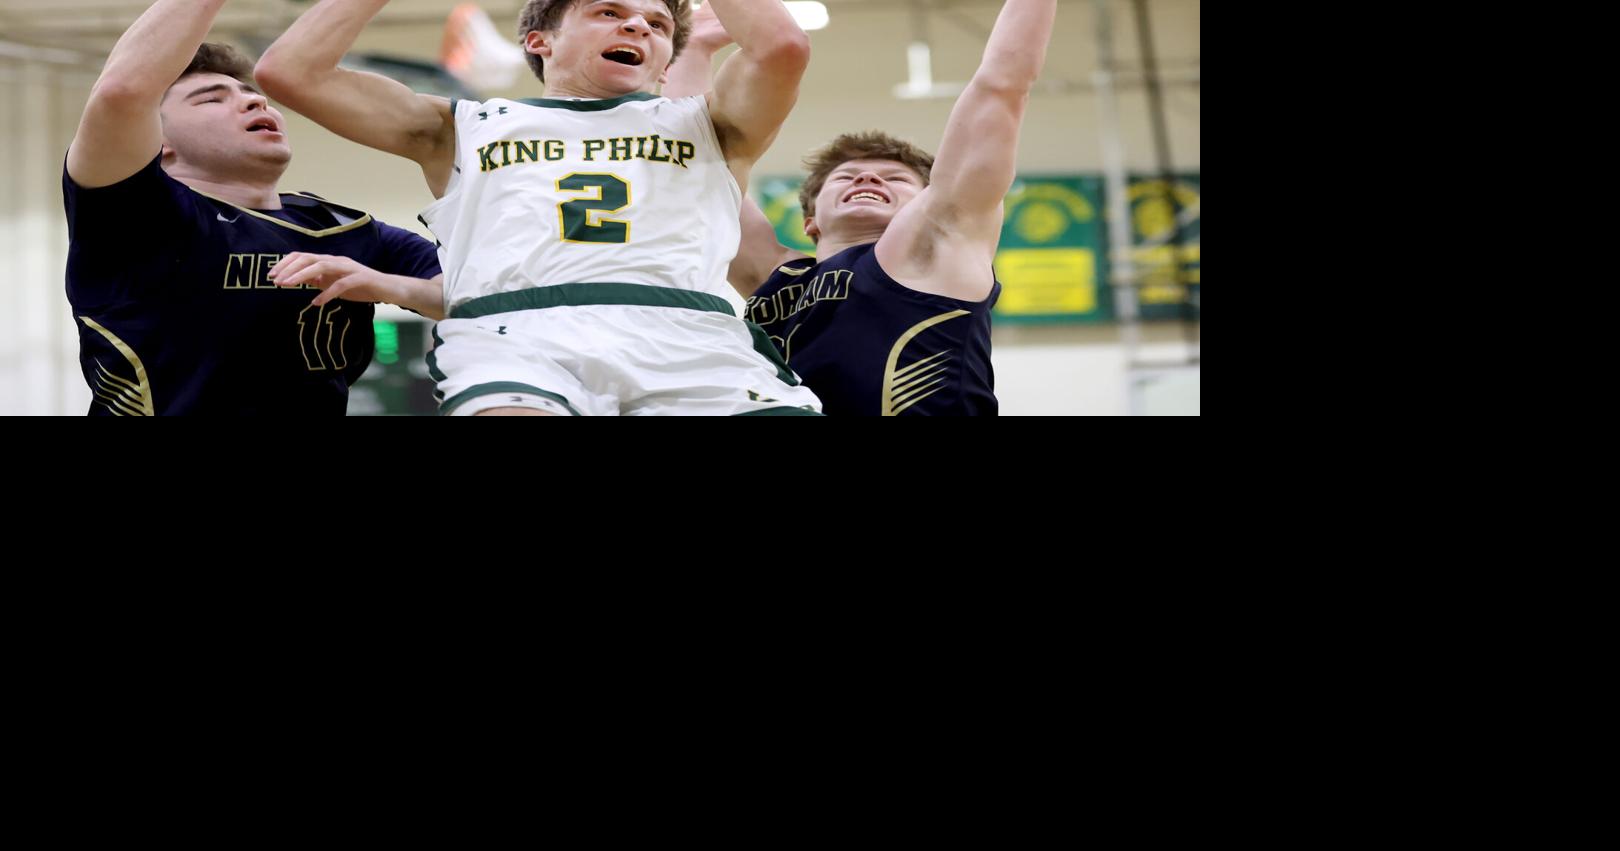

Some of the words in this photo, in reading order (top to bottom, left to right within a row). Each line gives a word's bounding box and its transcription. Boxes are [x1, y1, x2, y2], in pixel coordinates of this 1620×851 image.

[477, 139, 565, 172] KING
[554, 171, 632, 244] 2
[297, 302, 351, 371] 11
